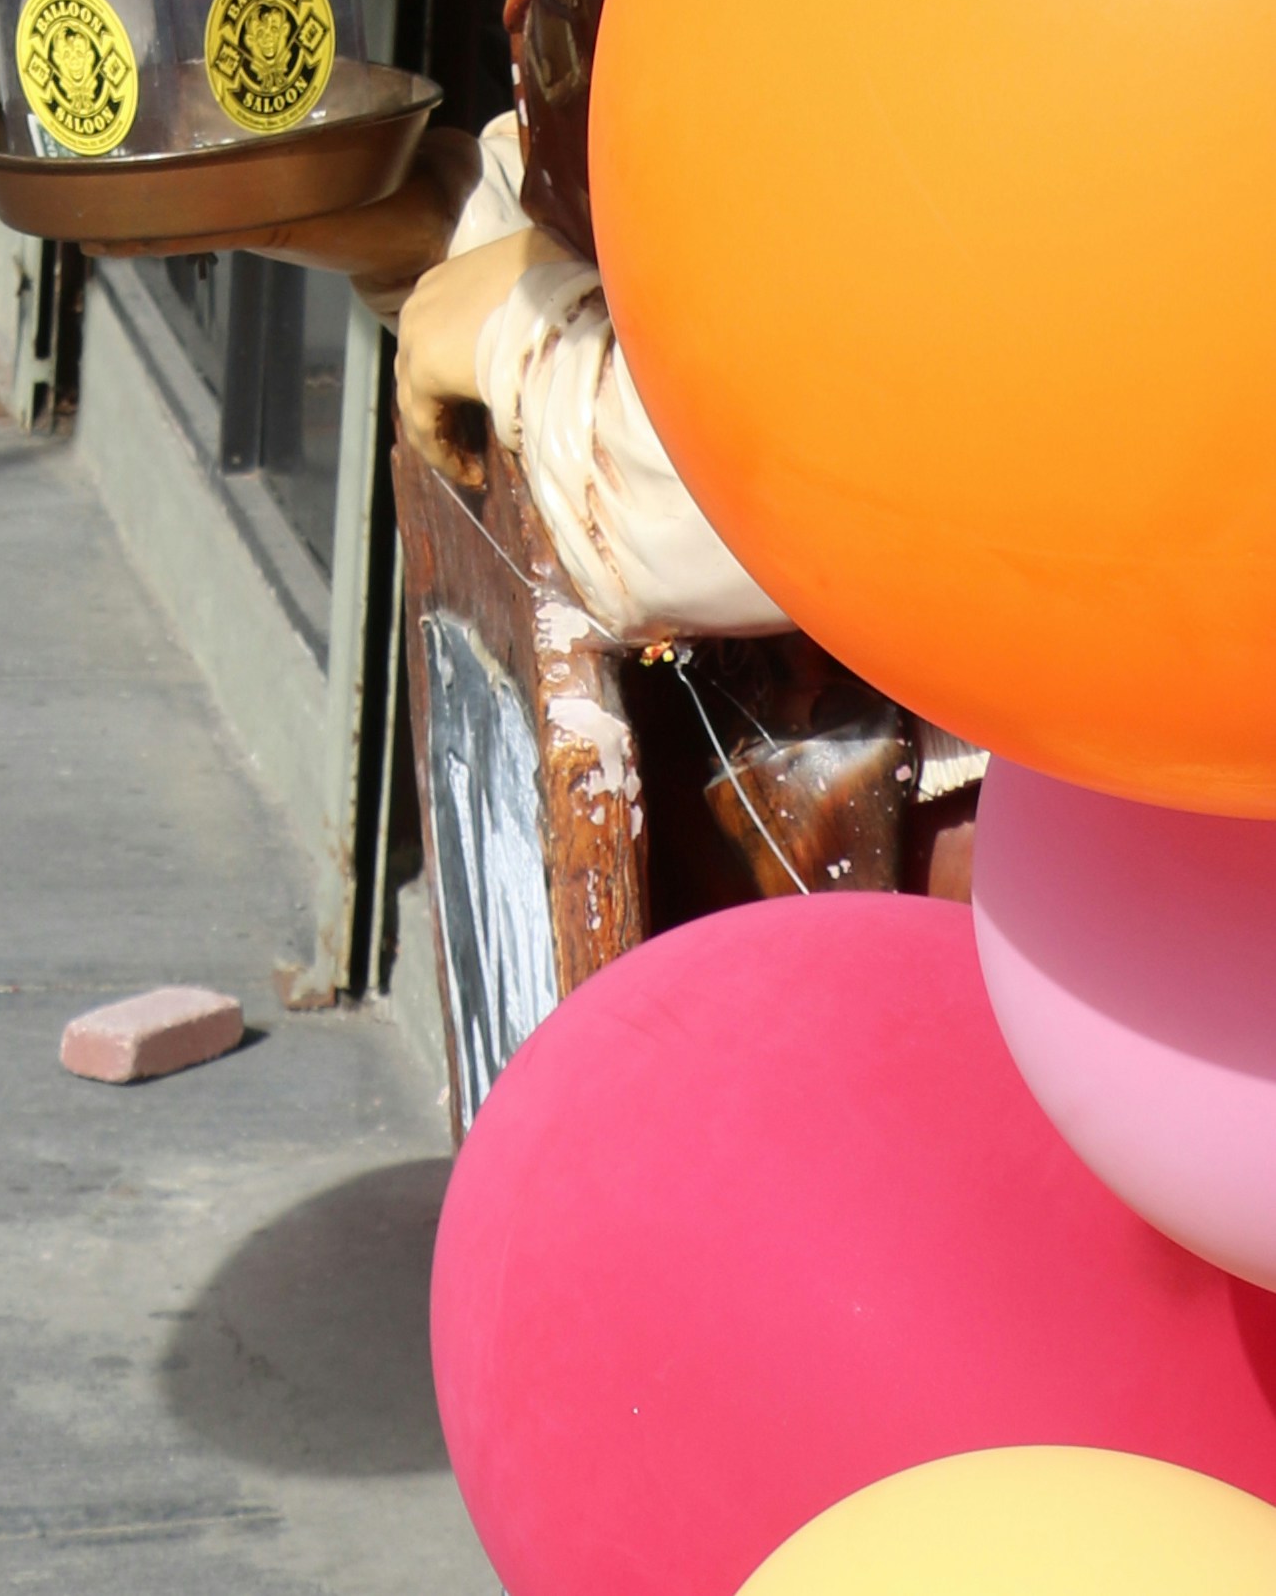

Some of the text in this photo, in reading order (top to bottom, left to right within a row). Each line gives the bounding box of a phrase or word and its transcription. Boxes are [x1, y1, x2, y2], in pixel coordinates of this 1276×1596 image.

[35, 1, 103, 34] BALLOON
[243, 76, 308, 113] SALOON
[55, 106, 115, 134] SALOON
